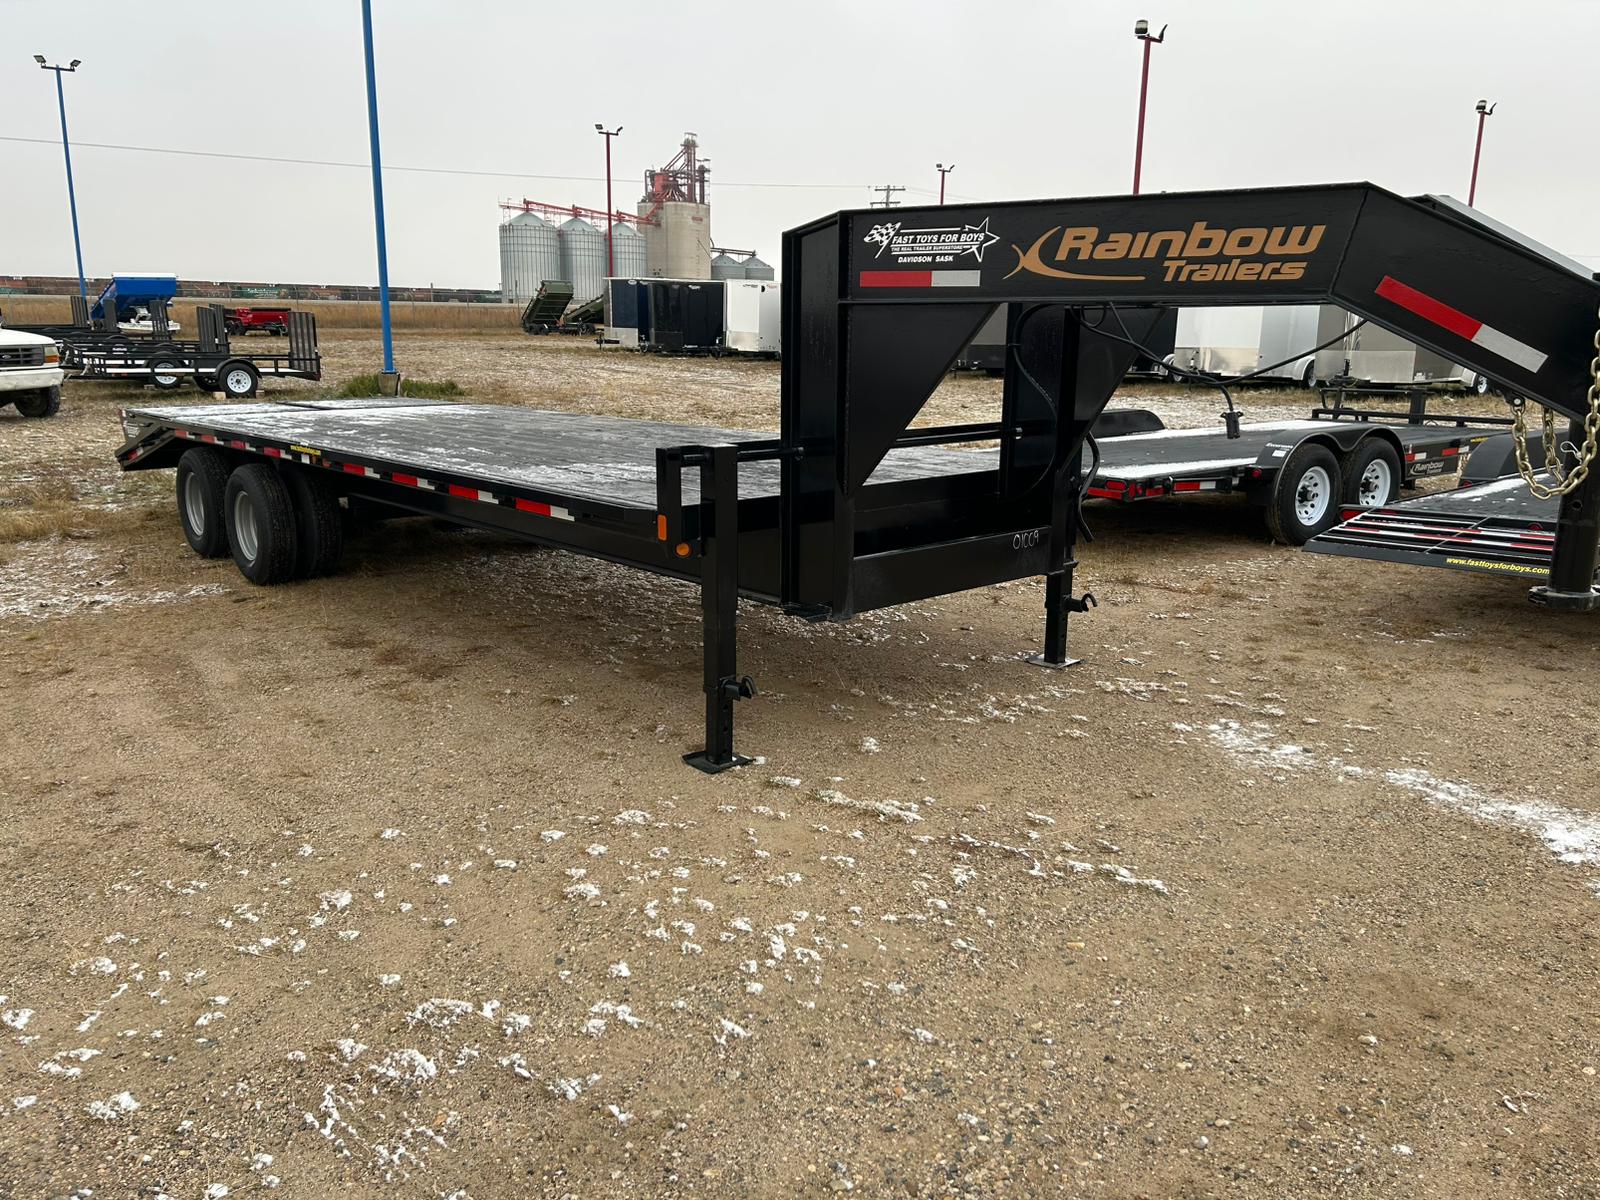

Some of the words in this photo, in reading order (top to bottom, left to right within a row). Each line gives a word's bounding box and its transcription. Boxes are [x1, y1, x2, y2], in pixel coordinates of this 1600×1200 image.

[892, 235, 914, 244] FAST
[915, 234, 939, 243] TOYS
[939, 233, 958, 242] FOR
[959, 232, 985, 242] BOYS
[1054, 221, 1326, 261] Rainbow
[1163, 258, 1308, 282] Trailers
[1446, 557, 1550, 575] www.fasttoysforboys.com
